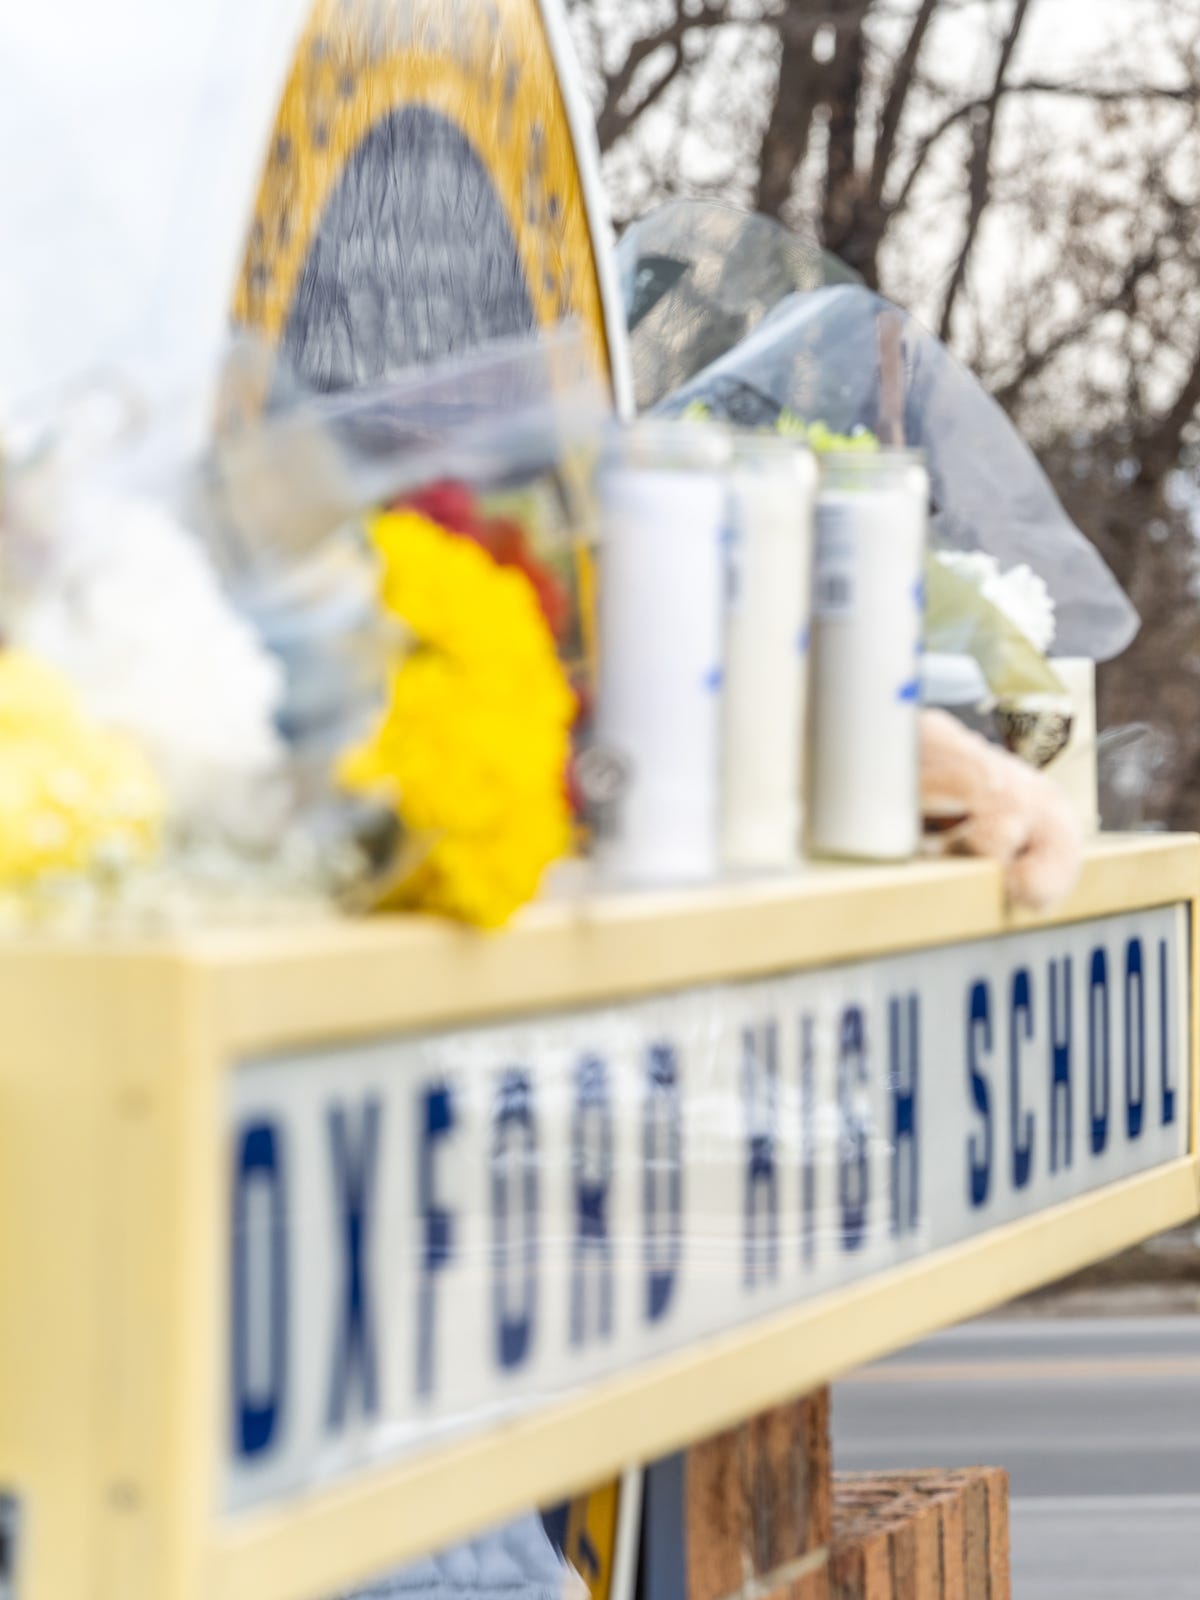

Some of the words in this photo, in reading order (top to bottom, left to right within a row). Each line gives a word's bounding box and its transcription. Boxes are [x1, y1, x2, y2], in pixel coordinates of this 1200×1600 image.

[229, 1038, 686, 1465] OXFORD
[741, 990, 923, 1294] HIGH
[966, 934, 1178, 1211] SCHOOL
